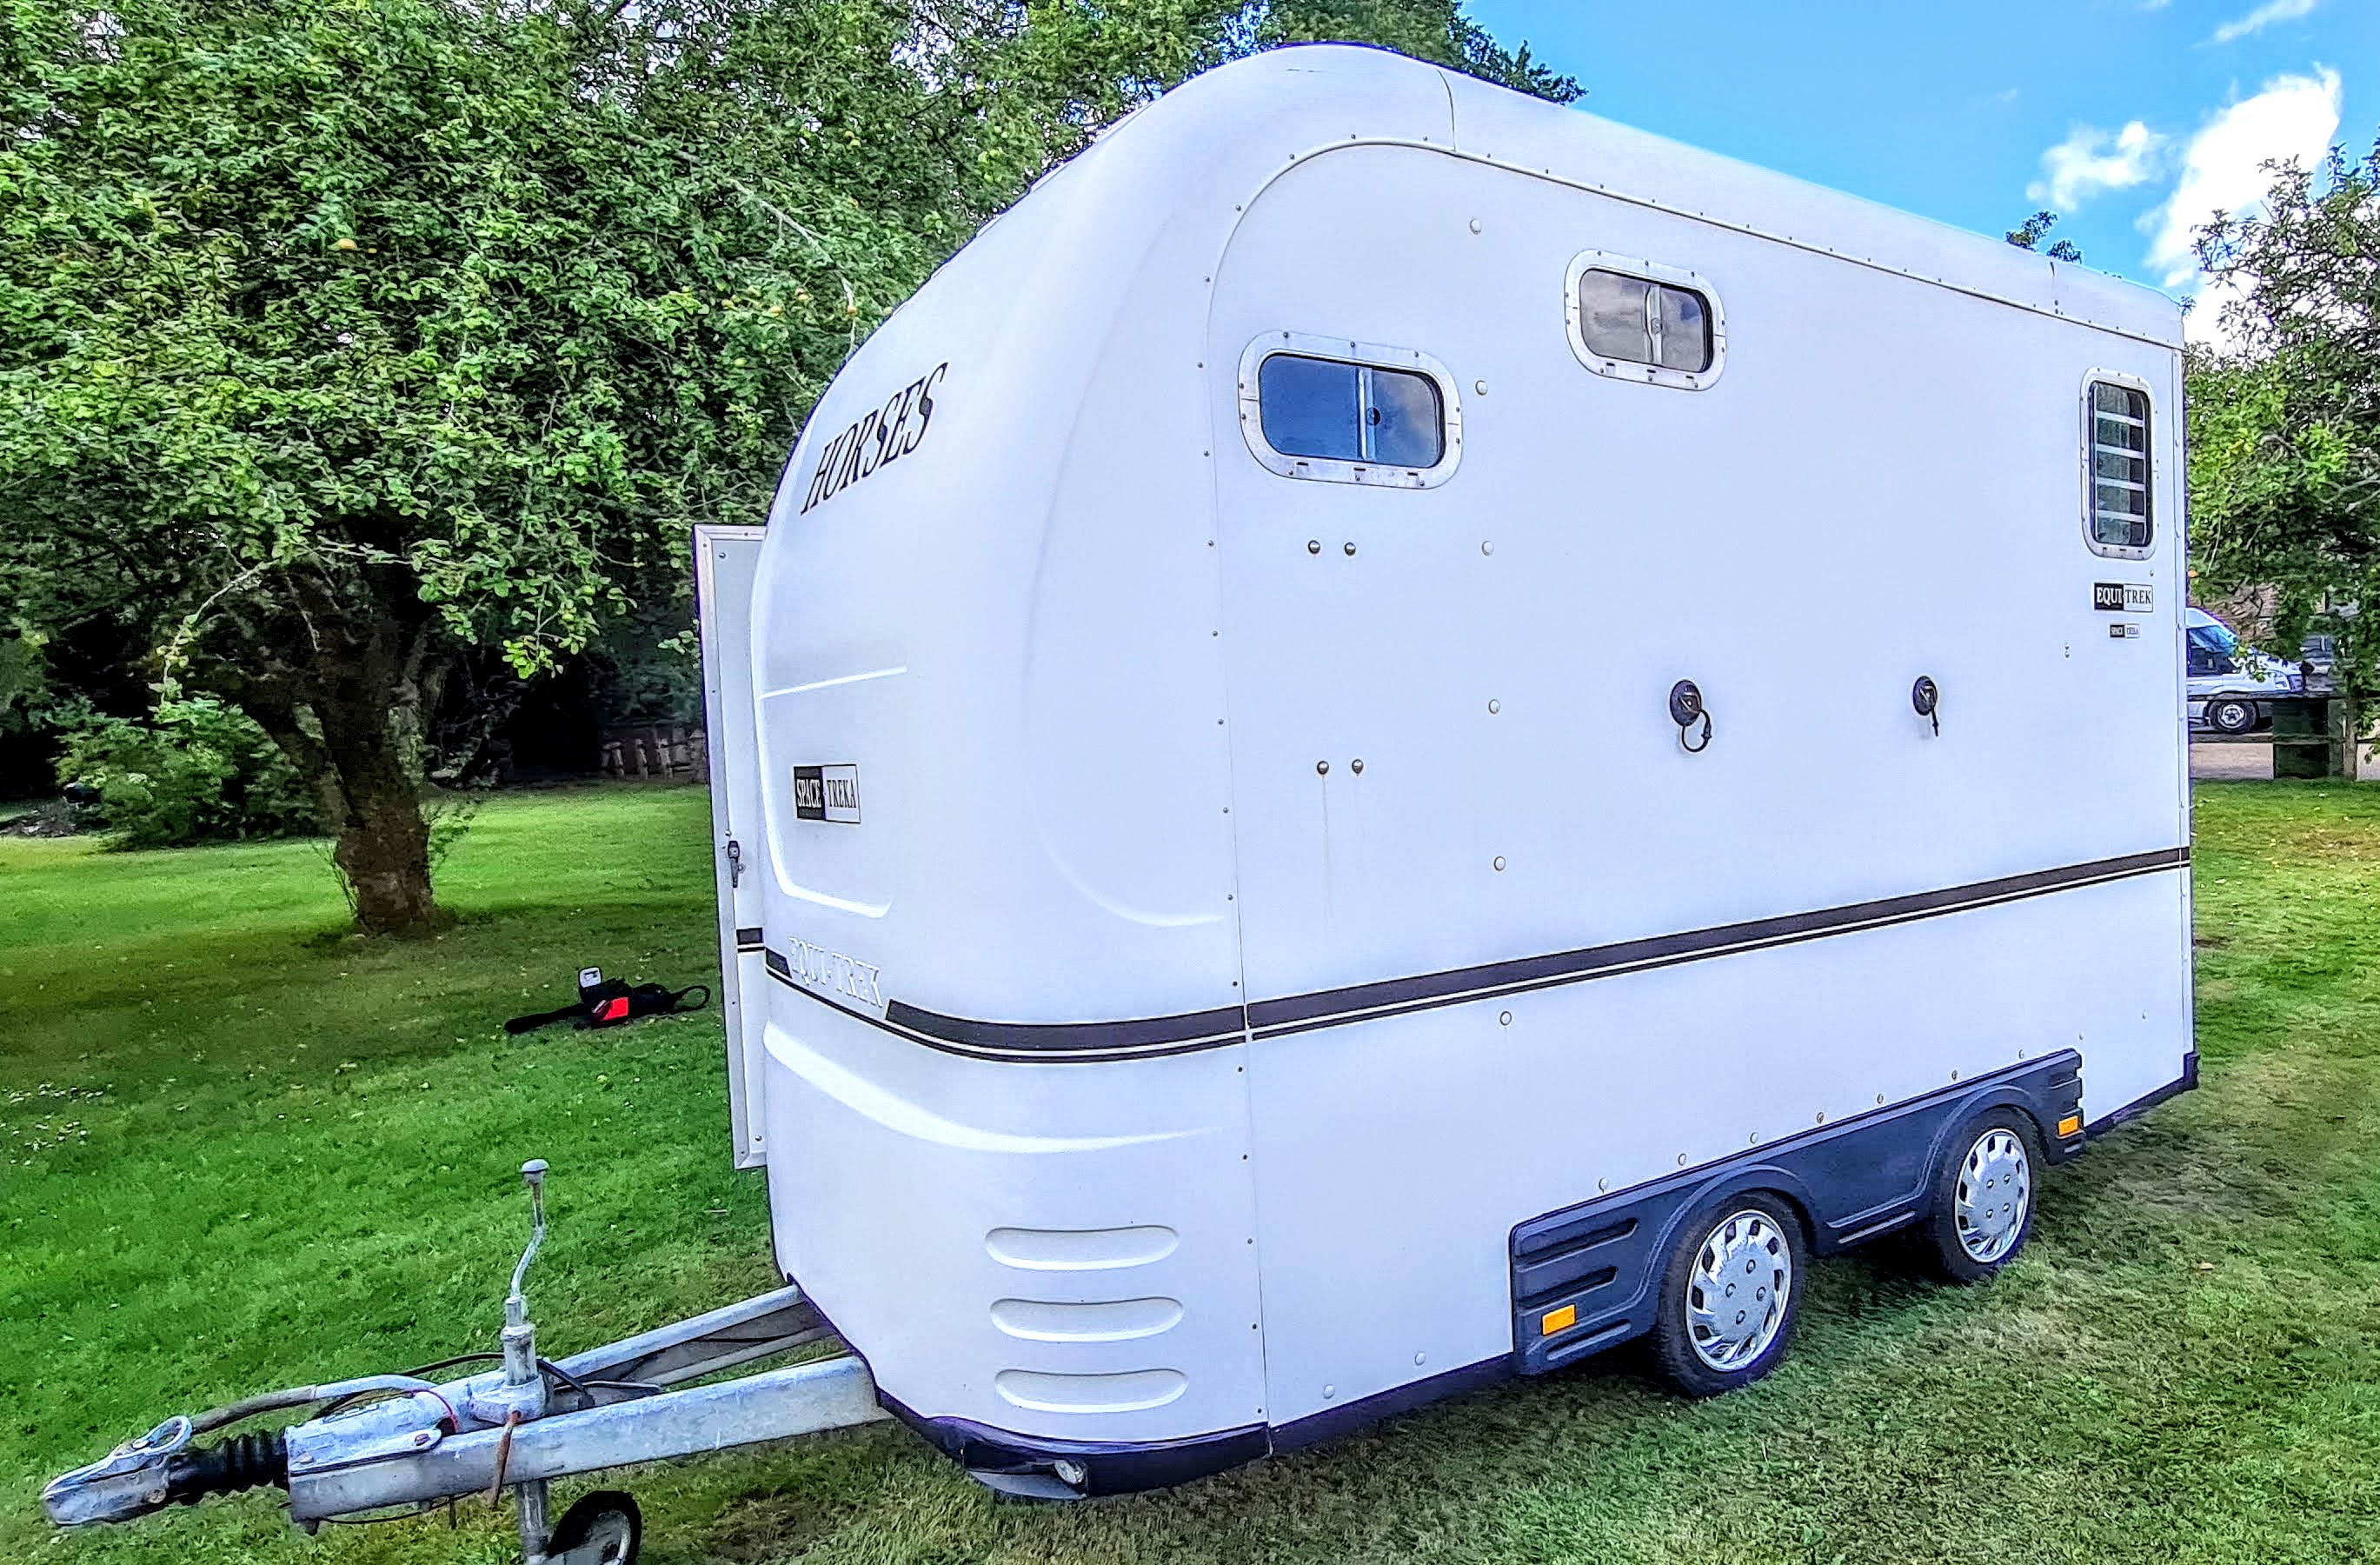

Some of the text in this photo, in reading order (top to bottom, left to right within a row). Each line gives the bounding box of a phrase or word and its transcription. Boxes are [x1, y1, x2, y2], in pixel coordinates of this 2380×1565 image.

[801, 362, 949, 516] HORSES
[2096, 587, 2151, 606] EQUI TREK
[796, 779, 857, 809] SPACE TREKA
